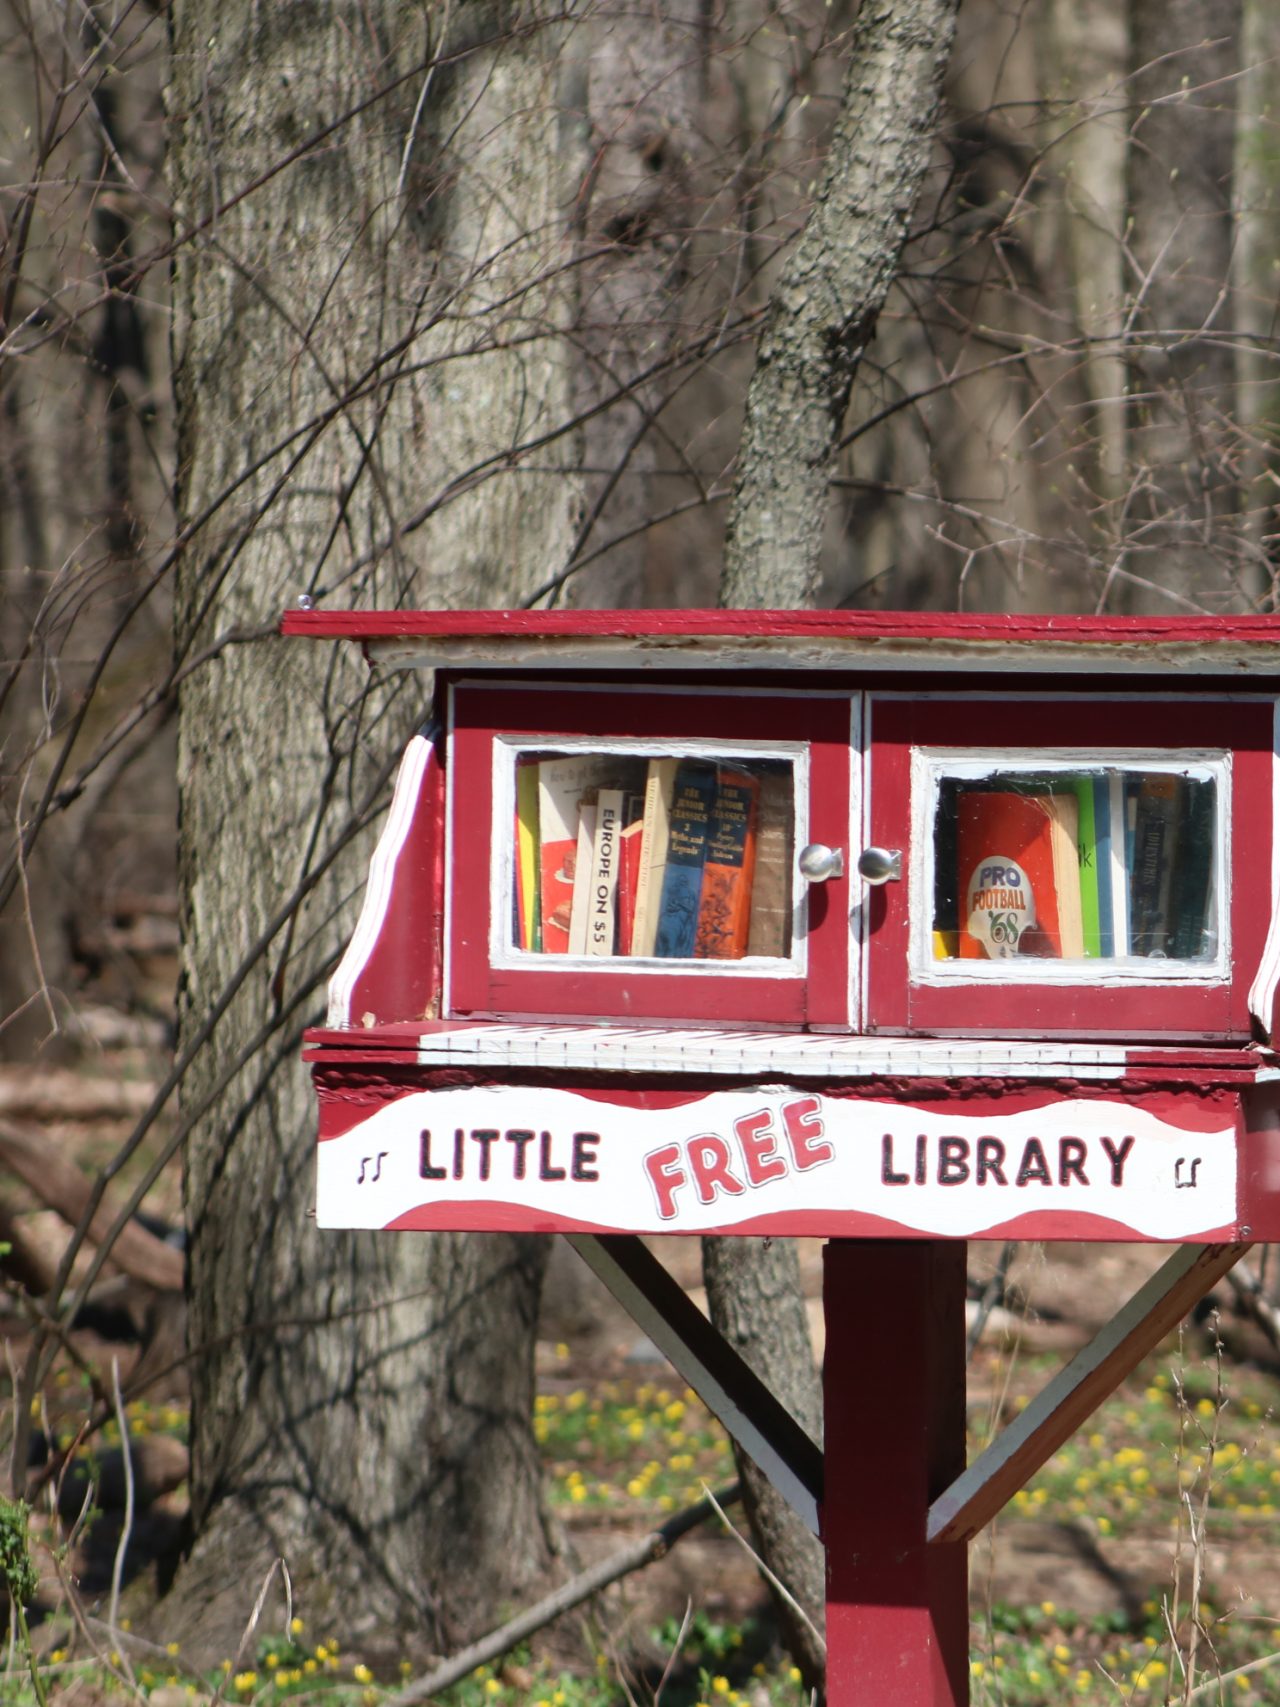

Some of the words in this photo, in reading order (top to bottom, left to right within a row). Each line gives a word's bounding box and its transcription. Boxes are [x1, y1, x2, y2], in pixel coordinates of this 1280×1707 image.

[599, 808, 615, 878] EUROPE
[979, 865, 1021, 888] PRO
[596, 888, 609, 914] ON
[972, 888, 1026, 912] FOOTBALL
[593, 920, 605, 943] $5
[418, 1128, 602, 1183] LITTLE
[643, 1092, 835, 1221] FREE
[881, 1133, 1136, 1188] LIBRARY
